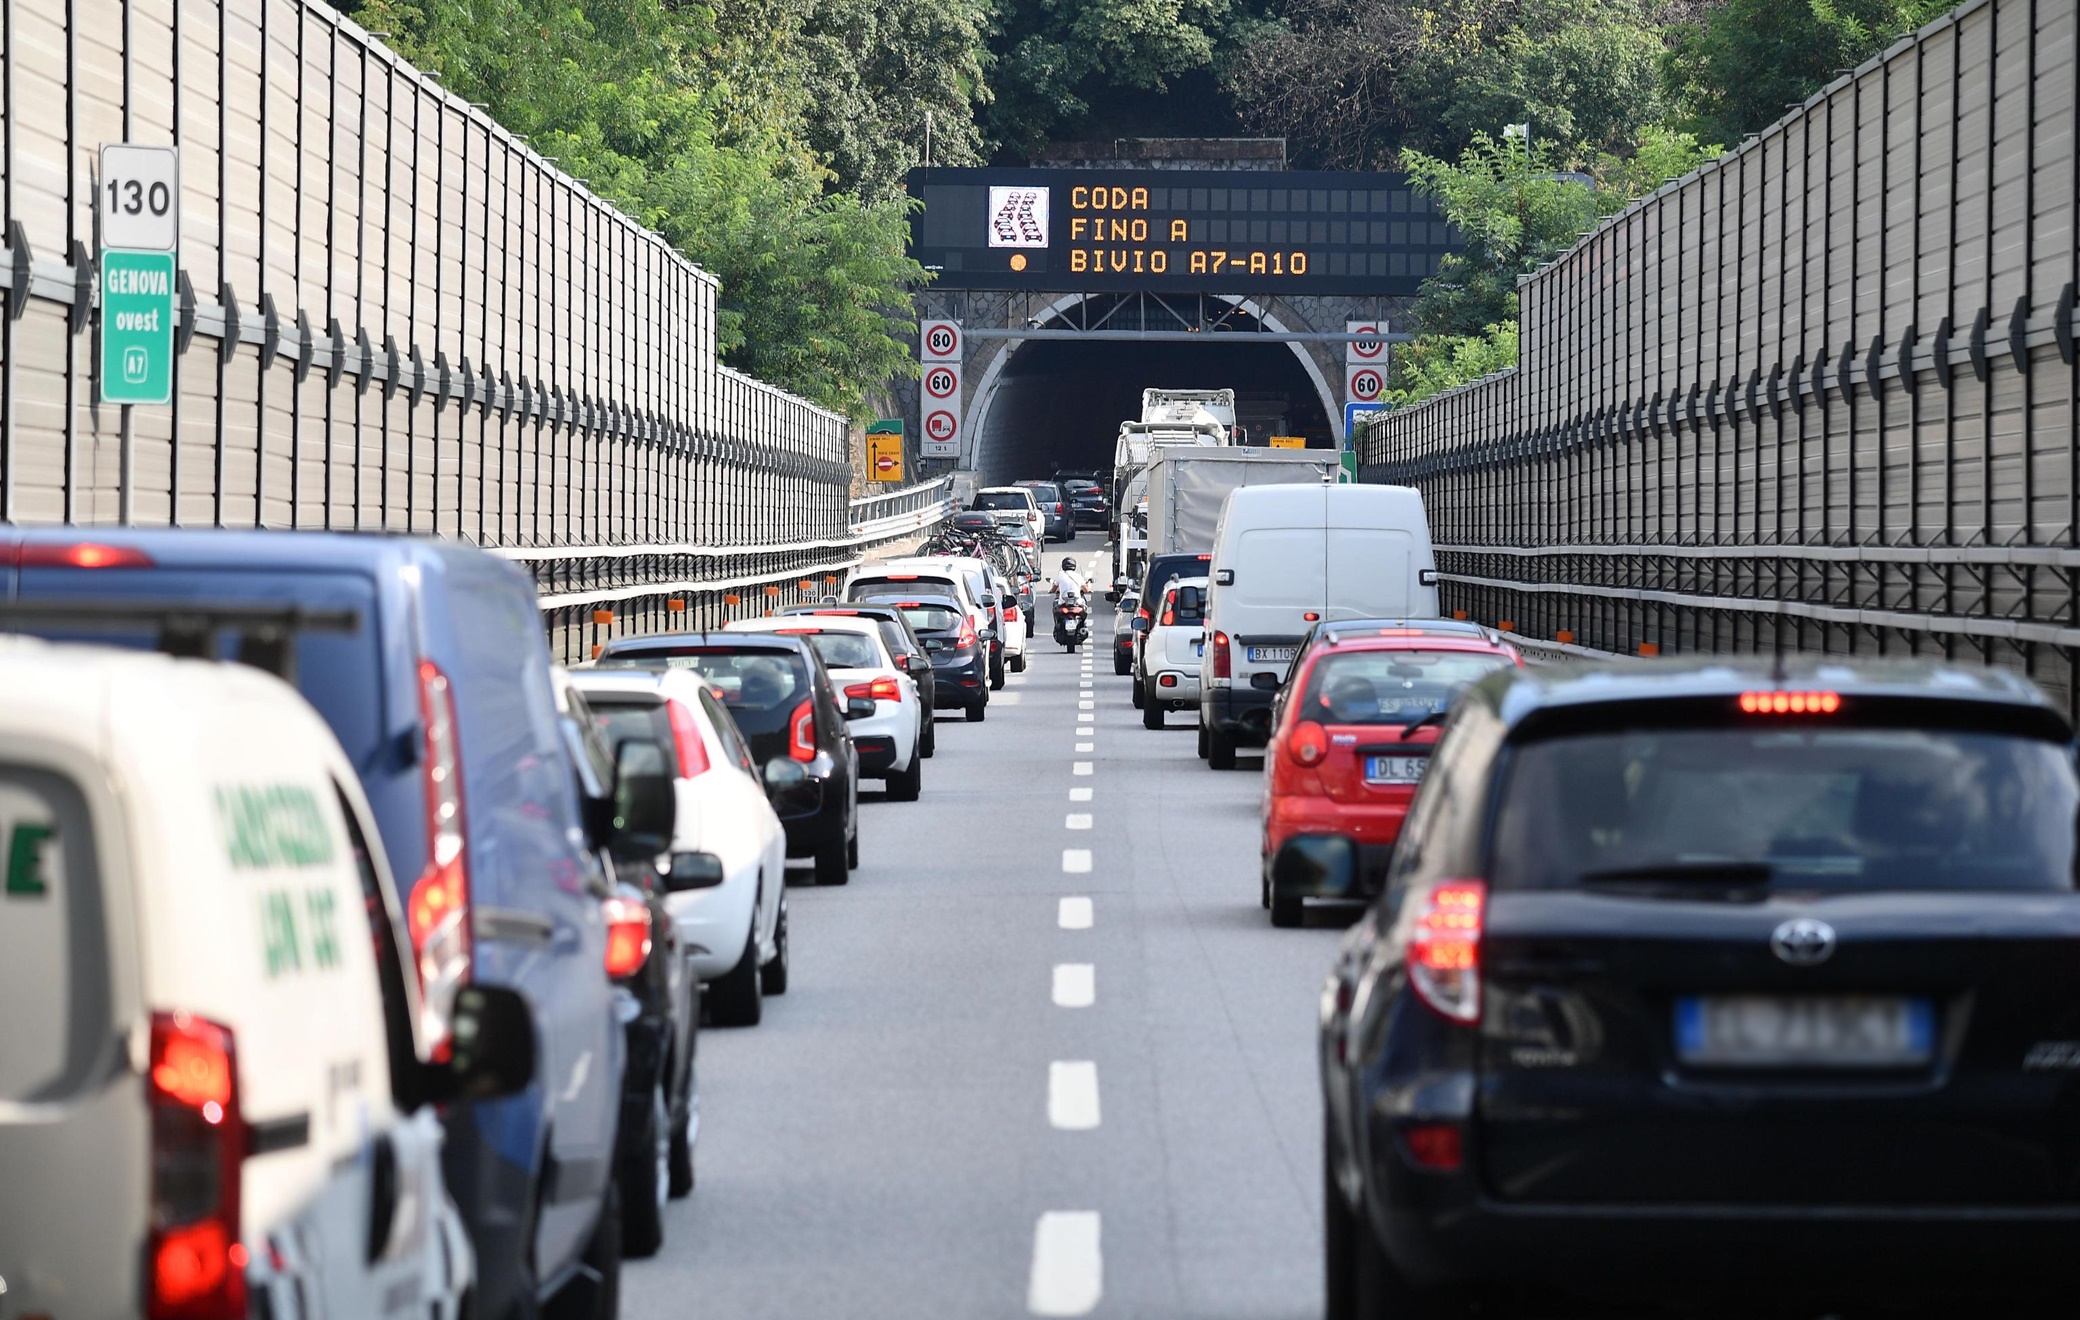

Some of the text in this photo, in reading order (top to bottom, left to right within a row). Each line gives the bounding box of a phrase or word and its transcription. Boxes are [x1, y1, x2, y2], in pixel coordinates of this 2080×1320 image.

[107, 179, 170, 216] 130
[1071, 186, 1148, 210] CODA
[1071, 218, 1187, 242] FINO A
[1071, 249, 1307, 275] BIVIO A7-A10
[108, 269, 168, 295] GENOVA
[116, 309, 159, 332] ovest
[932, 333, 951, 348] 80
[127, 355, 144, 374] A7
[932, 375, 951, 390] 60
[1357, 377, 1376, 393] 60
[1255, 648, 1268, 660] BX
[1378, 759, 1397, 777] DL
